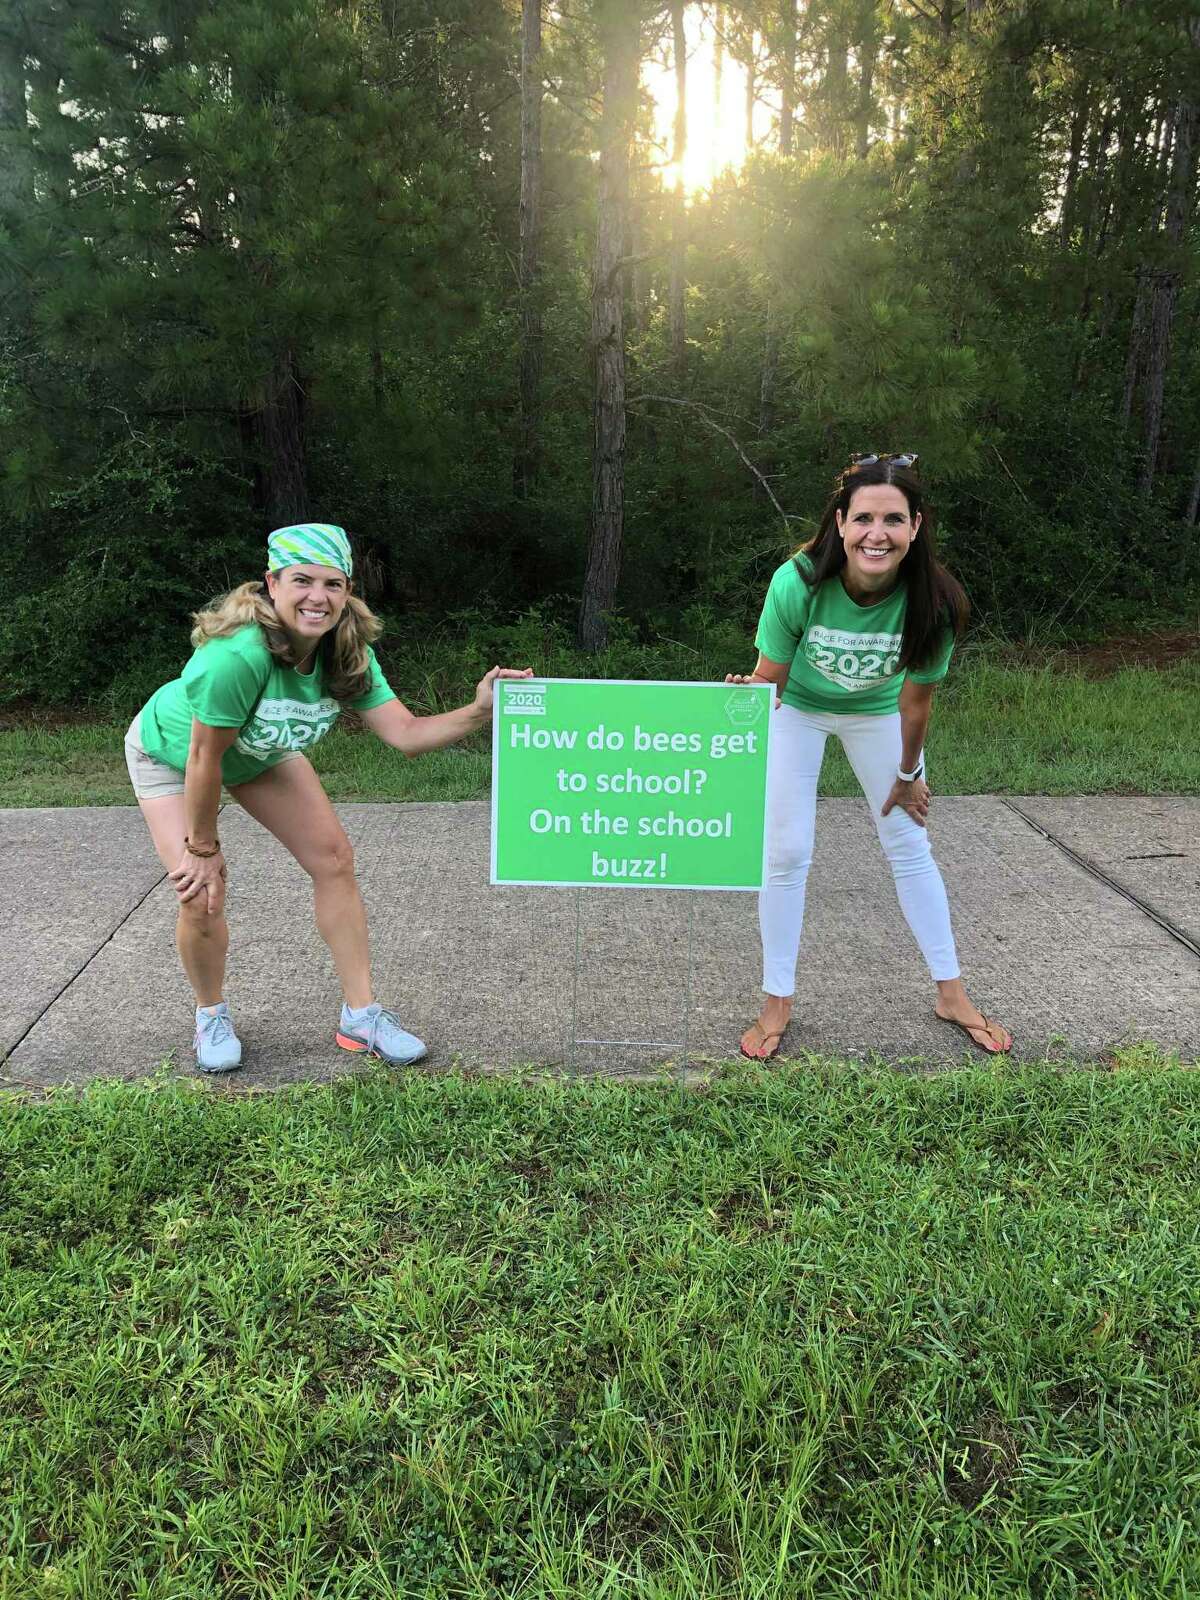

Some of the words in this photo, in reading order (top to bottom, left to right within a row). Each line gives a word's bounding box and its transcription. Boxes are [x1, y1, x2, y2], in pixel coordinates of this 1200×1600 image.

[838, 637, 856, 646] FOR
[815, 650, 900, 676] 2020
[507, 692, 543, 706] 2020
[510, 723, 578, 749] How
[587, 724, 624, 751] do
[634, 725, 702, 751] bees
[709, 730, 758, 759] get
[557, 768, 587, 792] to
[596, 768, 708, 794] school?
[529, 809, 571, 834] On
[580, 809, 629, 835] the
[638, 811, 732, 838] school
[591, 851, 668, 879] buzz!
